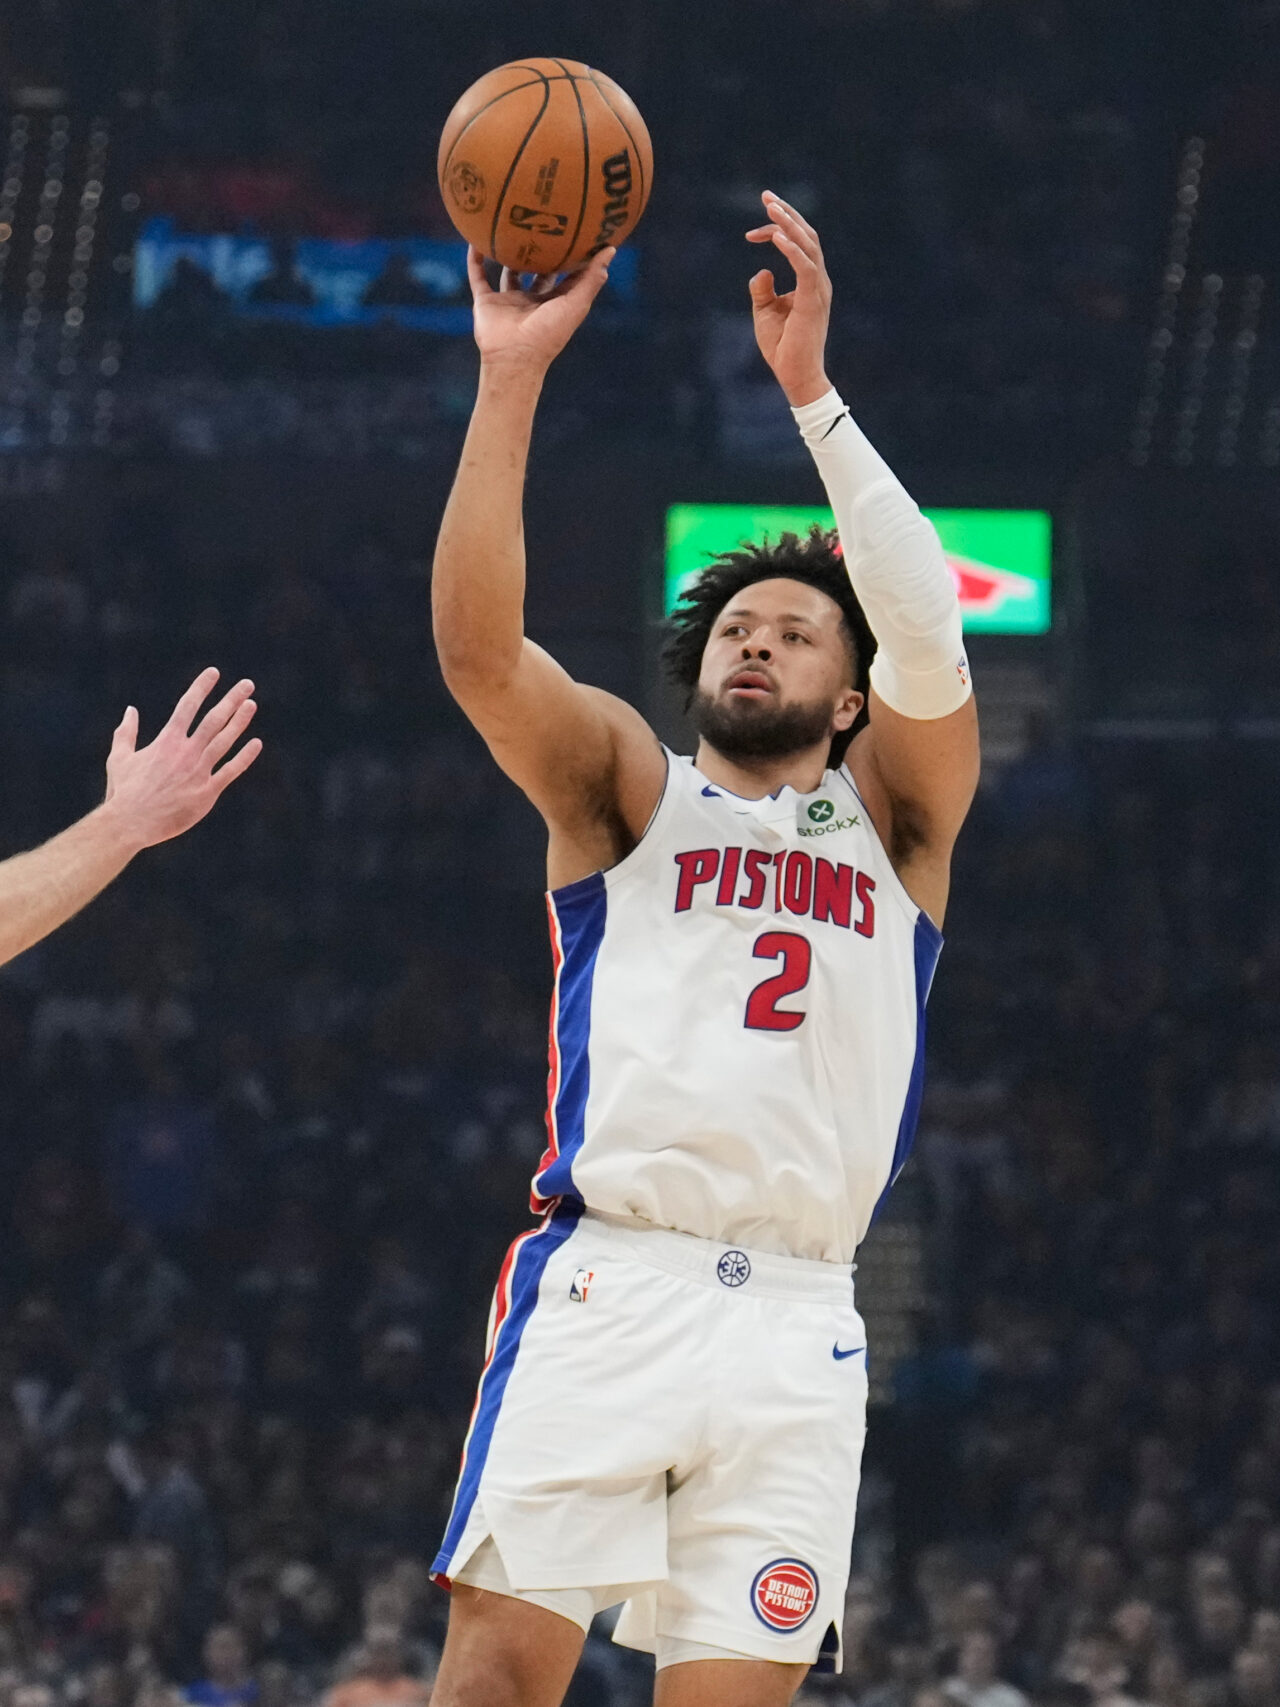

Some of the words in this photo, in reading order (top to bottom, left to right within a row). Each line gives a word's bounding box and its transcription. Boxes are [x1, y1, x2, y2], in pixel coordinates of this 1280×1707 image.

[674, 847, 877, 940] PISTONS
[744, 931, 812, 1031] 2
[766, 1591, 807, 1613] PISTONS
[768, 1580, 810, 1601] DETROIT
